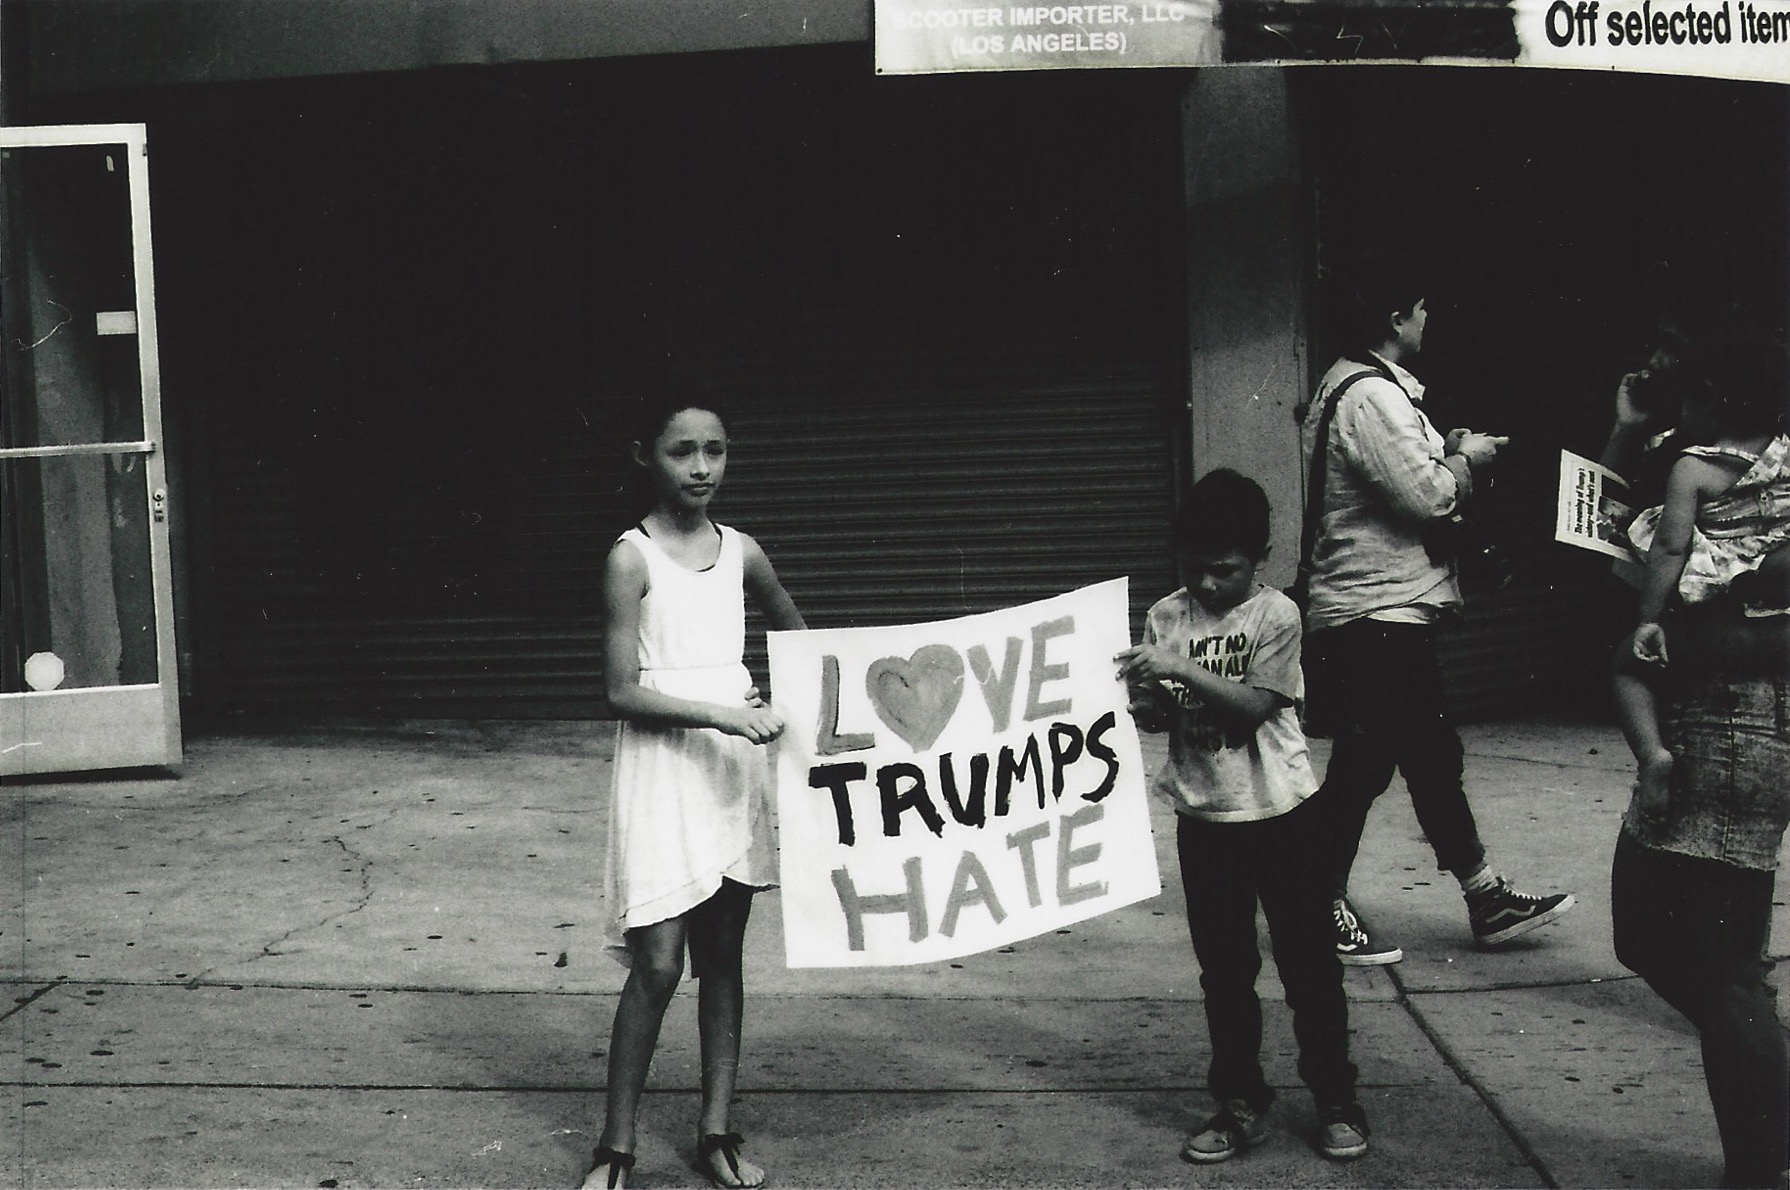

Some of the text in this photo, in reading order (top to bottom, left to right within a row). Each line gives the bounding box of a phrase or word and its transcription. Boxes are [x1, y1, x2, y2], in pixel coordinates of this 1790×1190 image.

[893, 2, 1185, 29] SCOOTER IMPORTER, LLC
[1545, 0, 1599, 47] Off
[1606, 0, 1731, 45] selected
[951, 32, 1127, 57] (LOS ANGELES)
[1225, 632, 1247, 655] NO
[808, 711, 1119, 847] TRUMPS
[831, 804, 1109, 951] HATE
